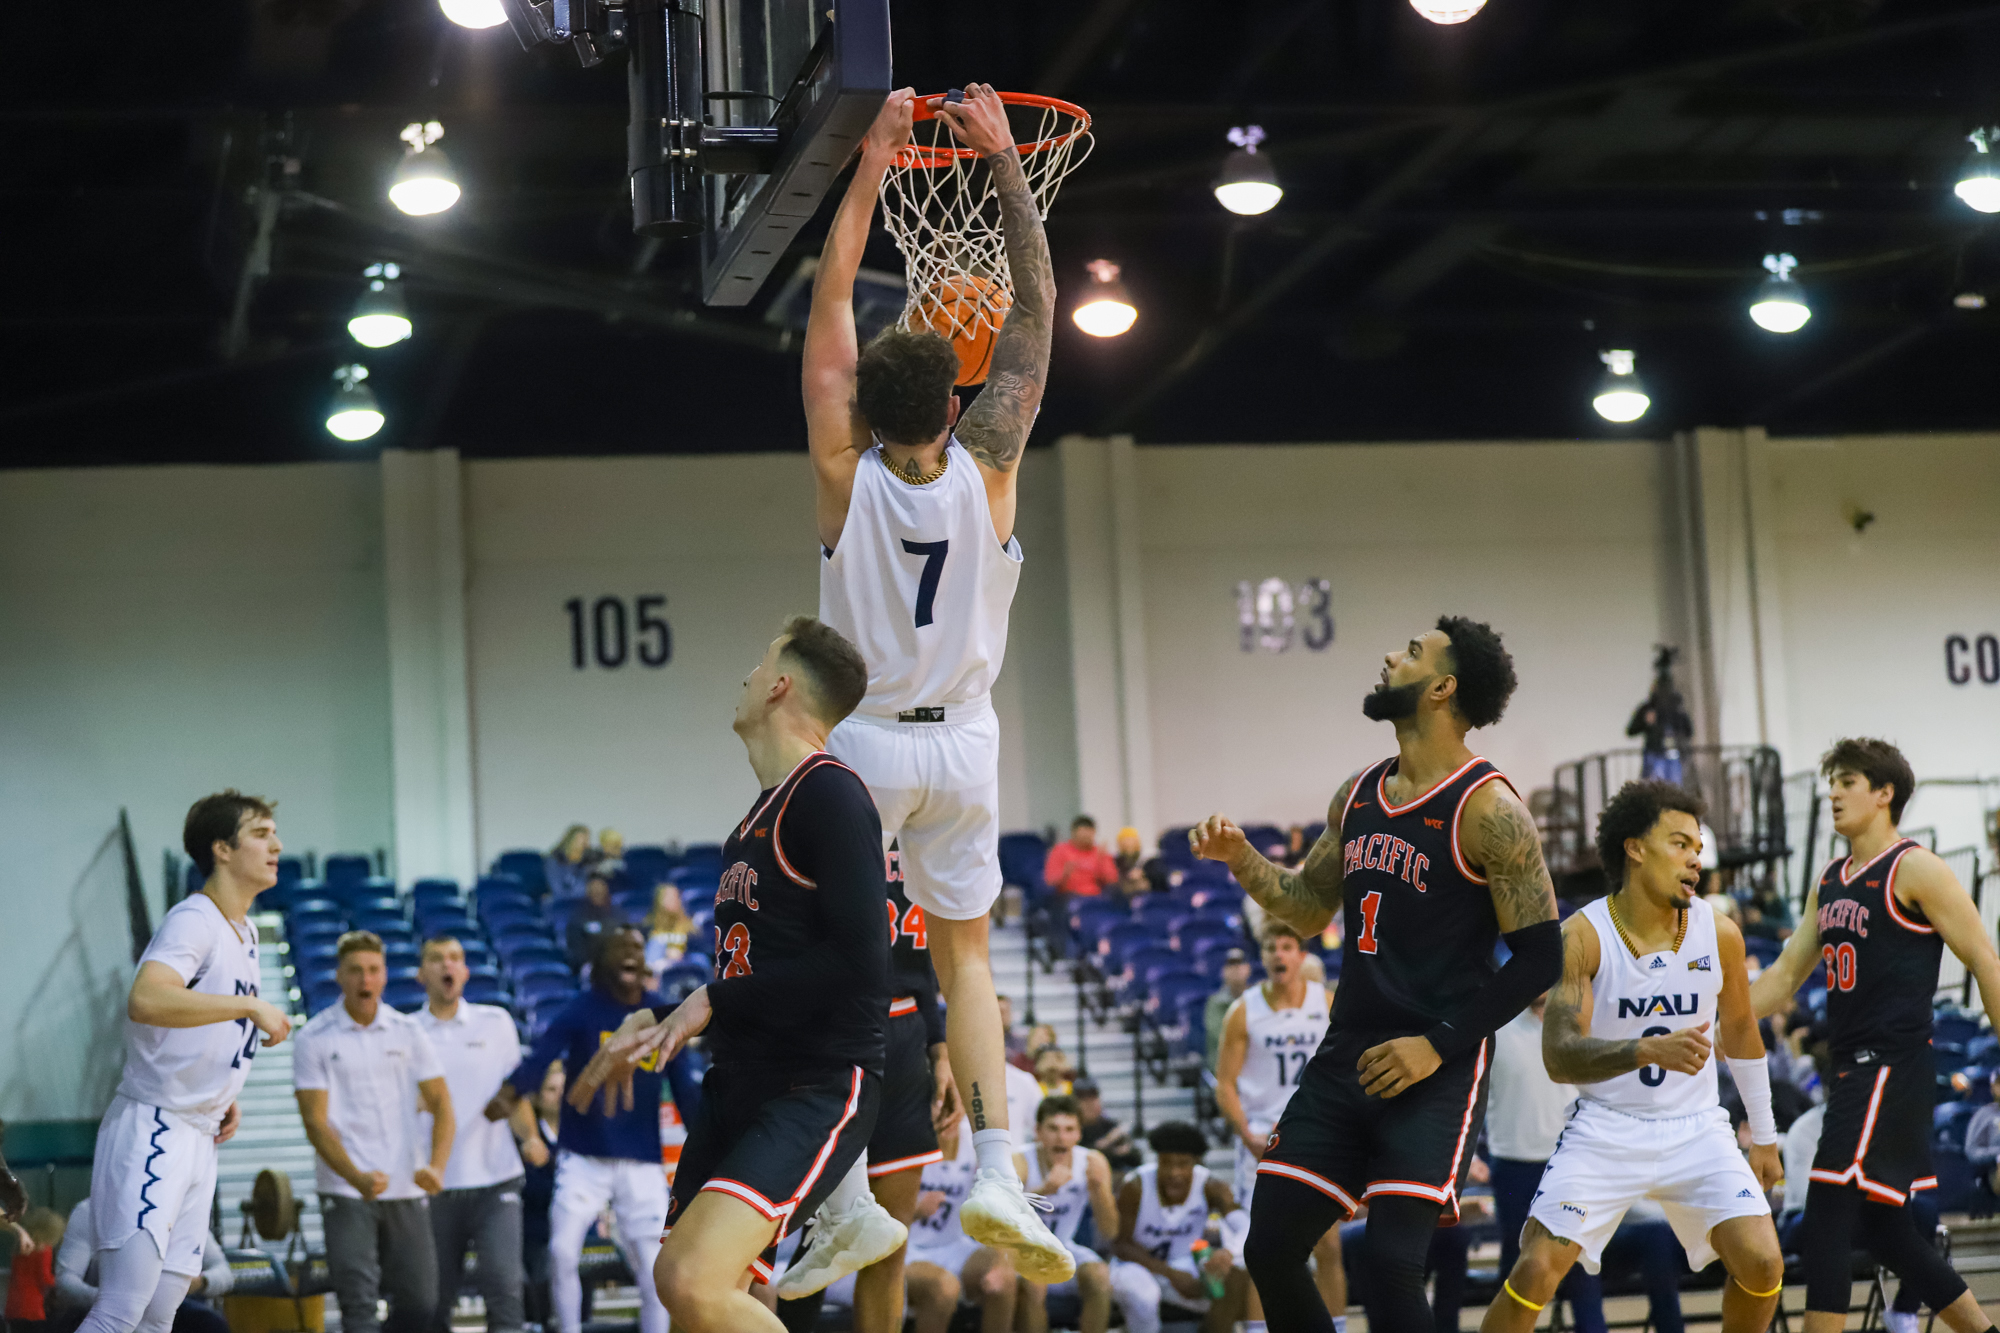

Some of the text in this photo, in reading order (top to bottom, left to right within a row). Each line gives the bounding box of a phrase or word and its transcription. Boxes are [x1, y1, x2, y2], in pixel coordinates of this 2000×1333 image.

[900, 537, 949, 629] 7
[565, 595, 672, 668] 105
[1231, 577, 1335, 652] 103
[1944, 633, 2000, 686] CO
[1344, 833, 1430, 893] PACIFIC
[1358, 890, 1382, 955] 1
[1618, 993, 1699, 1019] NAU
[1275, 1050, 1308, 1087] 12
